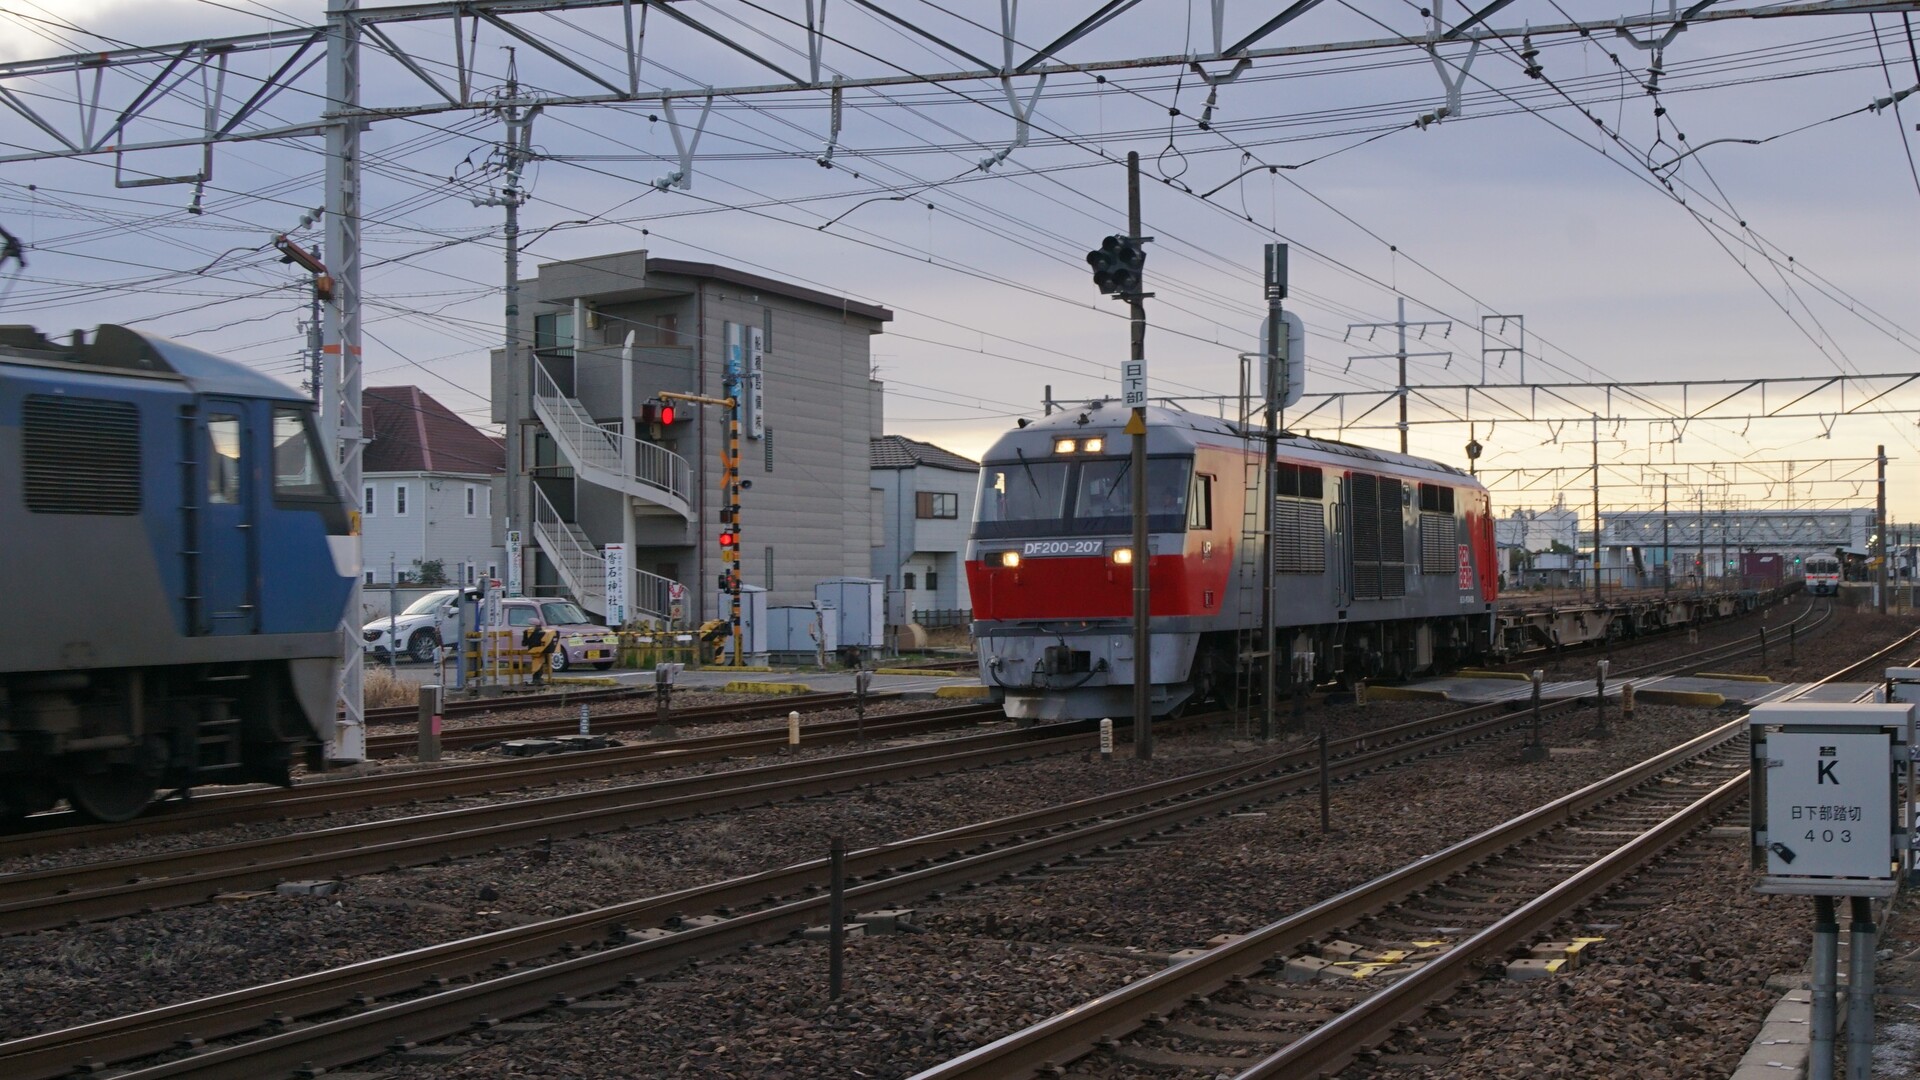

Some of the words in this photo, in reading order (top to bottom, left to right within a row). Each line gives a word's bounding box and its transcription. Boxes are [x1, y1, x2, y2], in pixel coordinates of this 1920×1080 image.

[1125, 364, 1143, 404] 日下部
[1024, 541, 1102, 555] DF200-207
[1817, 760, 1840, 785] K
[1791, 805, 1862, 822] 日下部踏切
[1804, 829, 1852, 843] 403
